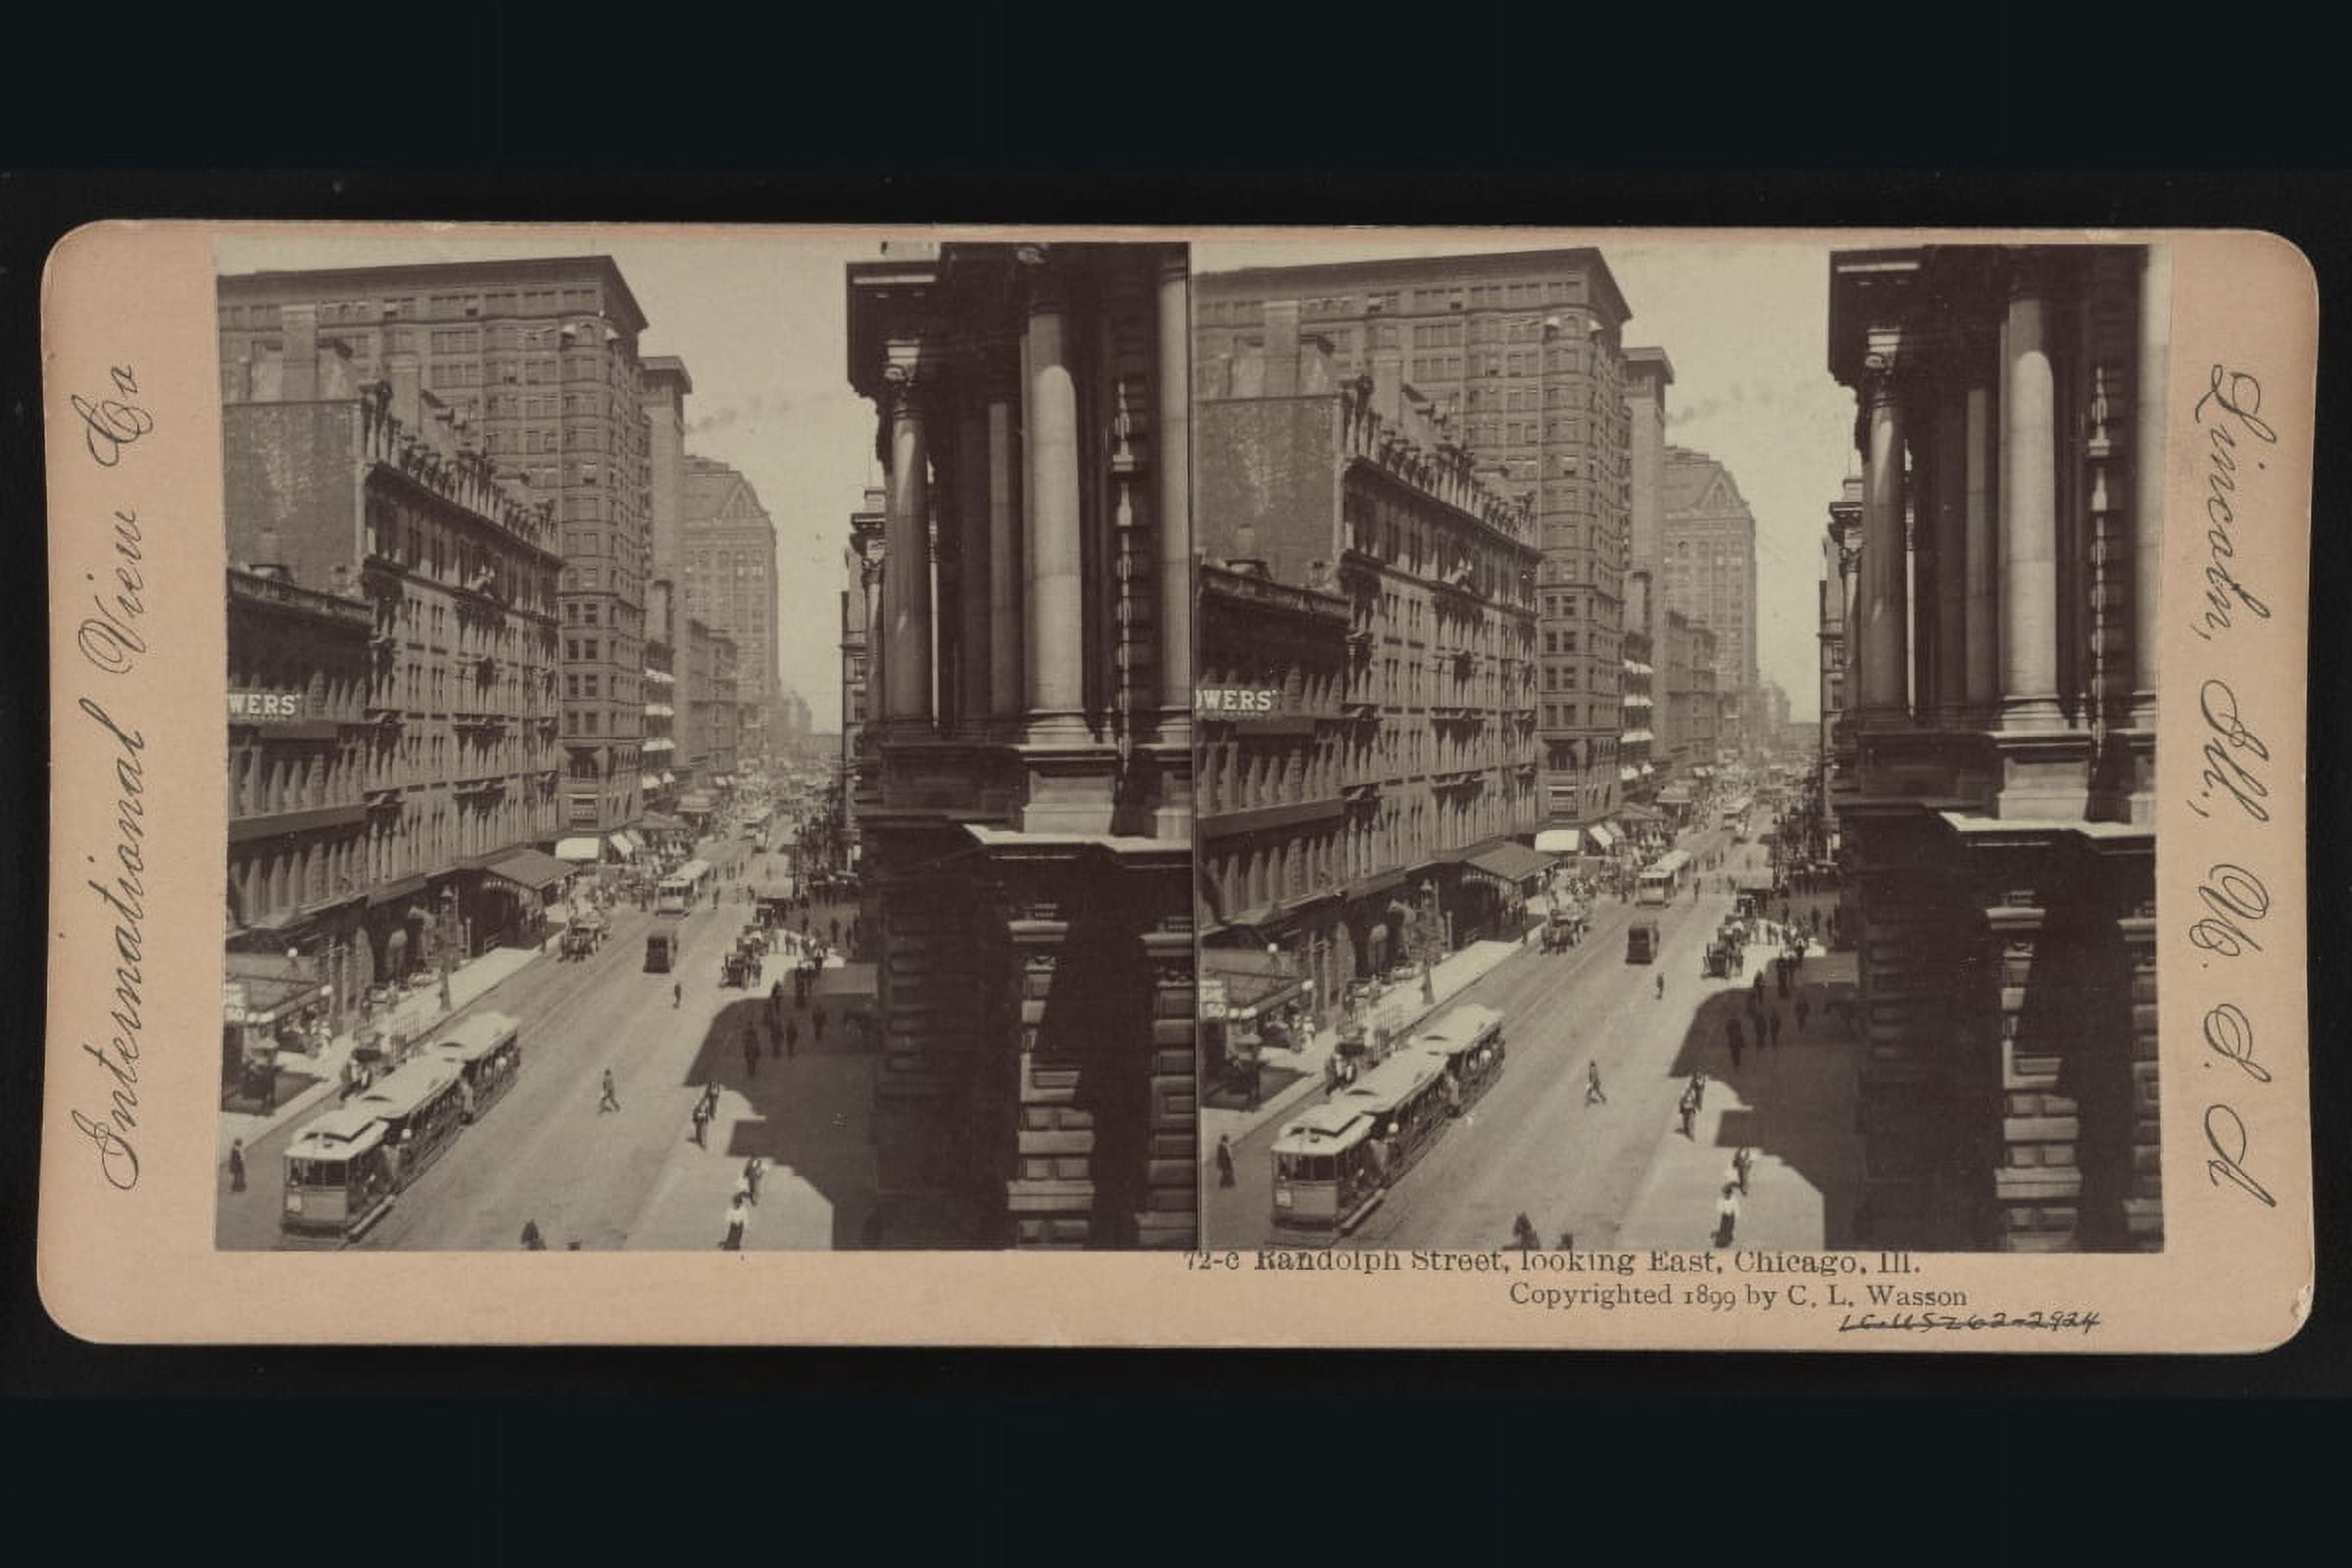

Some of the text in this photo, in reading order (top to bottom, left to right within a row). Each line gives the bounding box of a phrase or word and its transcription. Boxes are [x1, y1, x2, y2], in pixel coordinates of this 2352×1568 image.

[2190, 364, 2278, 642] Lincoln,
[77, 511, 147, 675] View
[1253, 1250, 1402, 1274] Randolph
[1411, 1250, 1510, 1274] Street,
[1520, 1250, 1636, 1276] looking
[1510, 1281, 1968, 1311] Copyrighted 1899 by C. L. Wasson
